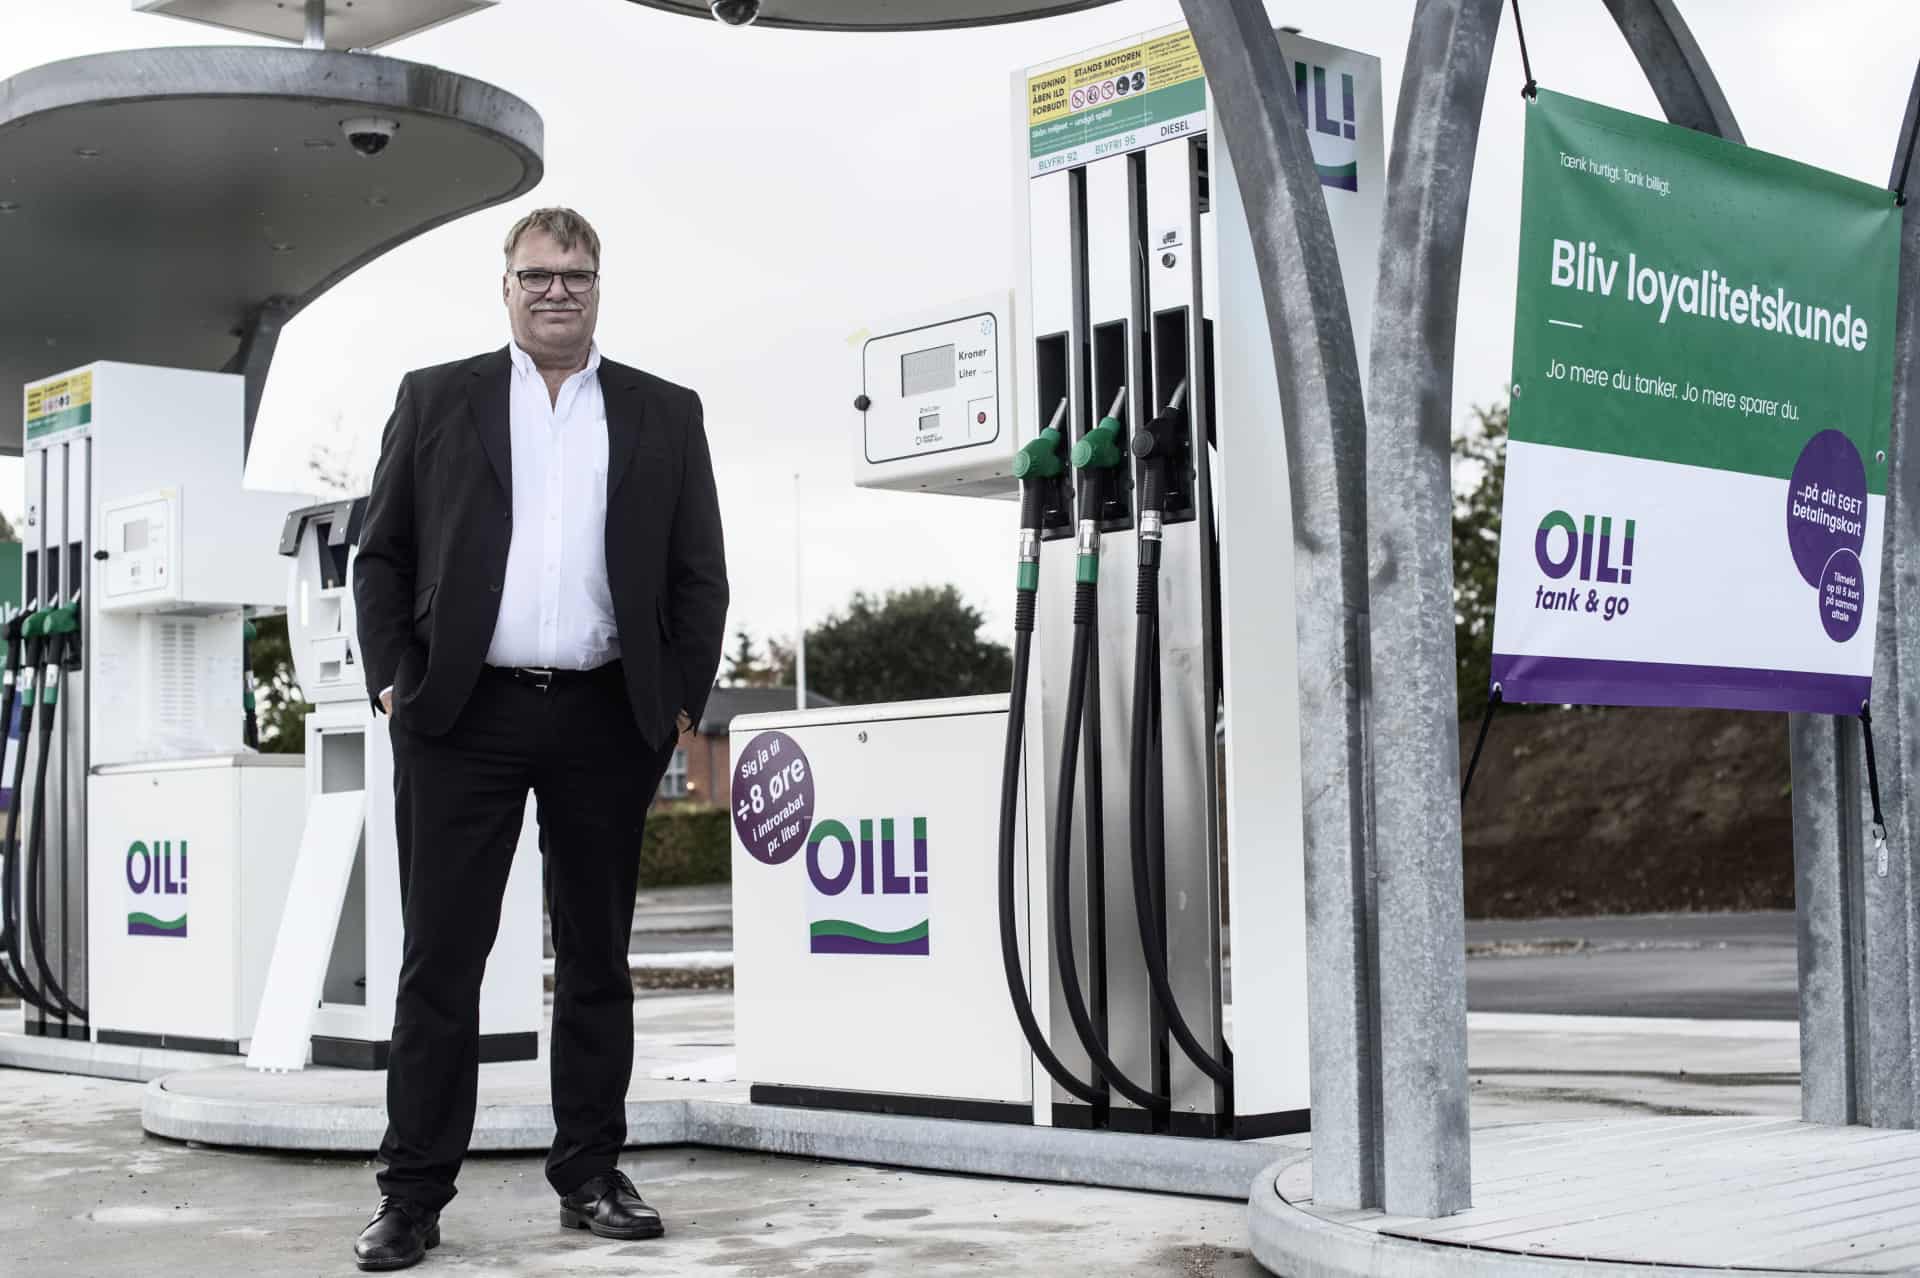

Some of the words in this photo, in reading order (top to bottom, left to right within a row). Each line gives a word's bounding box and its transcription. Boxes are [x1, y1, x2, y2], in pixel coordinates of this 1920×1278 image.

[1073, 62, 1102, 77] STANDS
[1103, 48, 1141, 68] MOTOREN
[1032, 75, 1066, 92] RYGNING
[1032, 92, 1052, 105] ÅBEN
[1053, 88, 1065, 98] ILD
[1032, 99, 1068, 116] FORBUDT!
[1295, 61, 1355, 140] IL!
[1160, 120, 1190, 136] DIESEL
[1039, 155, 1065, 169] BLYFRI
[1066, 151, 1077, 162] 92
[1095, 139, 1122, 154] BLYFRI
[1560, 152, 1587, 171] Tænk
[1589, 159, 1621, 183] hurtigt.
[1623, 169, 1644, 186] Tank
[1645, 174, 1671, 197] billigt.
[1551, 238, 1620, 296] Bliv
[1627, 252, 1868, 352] loyalitetskunde
[958, 348, 987, 361] Kroner
[959, 368, 977, 379] Liter
[1546, 359, 1566, 380] Jo
[1569, 364, 1609, 386] mere
[1612, 369, 1631, 391] du
[1634, 374, 1678, 399] tanker.
[1681, 382, 1699, 402] Jo
[1702, 388, 1736, 409] mere
[1739, 395, 1778, 417] sparer
[1781, 399, 1799, 421] du.
[1821, 488, 1836, 507] dit
[1837, 494, 1863, 515] EGET
[1792, 499, 1862, 537] betalingskort
[1535, 509, 1636, 585] OIL!
[1826, 584, 1835, 594] op
[1842, 586, 1847, 597] 5
[1847, 587, 1860, 601] kort
[1834, 571, 1856, 587] Tilmeld
[1535, 584, 1580, 611] tank
[1585, 588, 1599, 612] &
[1602, 595, 1629, 621] go
[1825, 595, 1834, 607] på
[1834, 599, 1858, 612] samme
[1831, 608, 1850, 622] aftale
[741, 760, 758, 779] Sig
[758, 749, 769, 770] ja
[770, 739, 781, 757] til
[769, 758, 805, 804] øre
[752, 828, 758, 842] i
[758, 793, 805, 839] introrabat
[767, 837, 781, 857] pr.
[781, 821, 801, 843] liter
[126, 840, 187, 895] OIL!
[805, 816, 929, 896] OIL!
